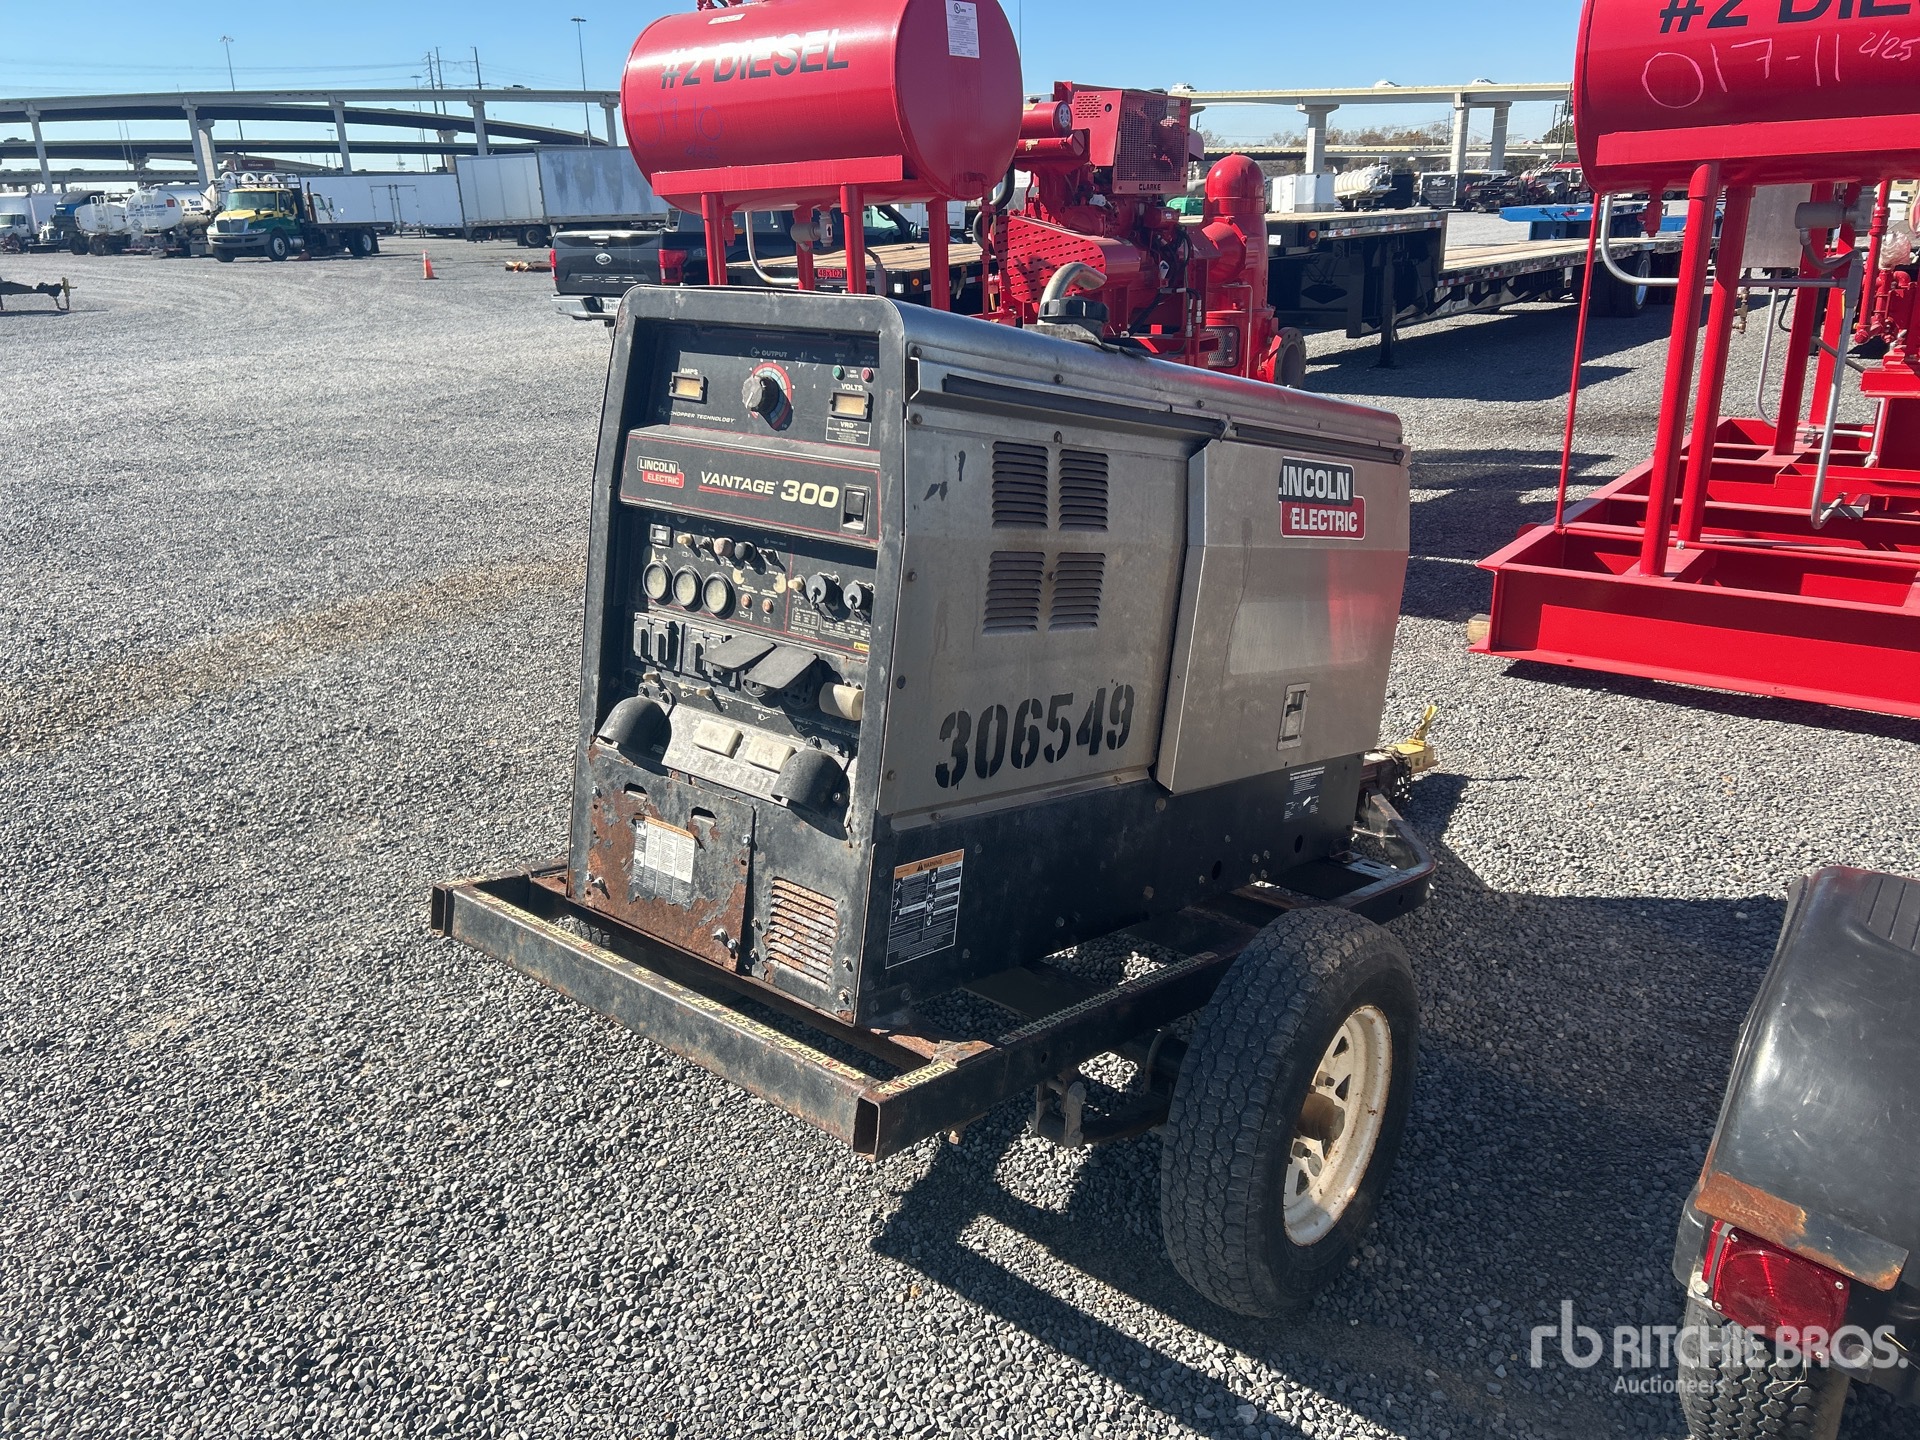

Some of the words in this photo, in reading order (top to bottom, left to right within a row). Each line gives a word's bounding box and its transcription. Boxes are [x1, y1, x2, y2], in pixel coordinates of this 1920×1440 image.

[713, 28, 849, 83] DIESEL
[1138, 183, 1162, 191] CLARKE
[818, 269, 842, 278] 48x102
[761, 349, 788, 358] OUTPUT
[680, 367, 699, 375] AMPS
[841, 383, 863, 391] VOLTS
[639, 458, 677, 474] LINCOLN
[647, 473, 680, 485] ELECTRIC
[1279, 465, 1350, 501] INCOLN
[701, 471, 775, 495] VANTAGE
[780, 479, 839, 509] 300
[1291, 507, 1358, 532] ELECTRIC
[935, 684, 1135, 789] 306549
[727, 1014, 747, 1025] NO
[795, 1045, 824, 1063] AQUI
[906, 1071, 926, 1085] DO
